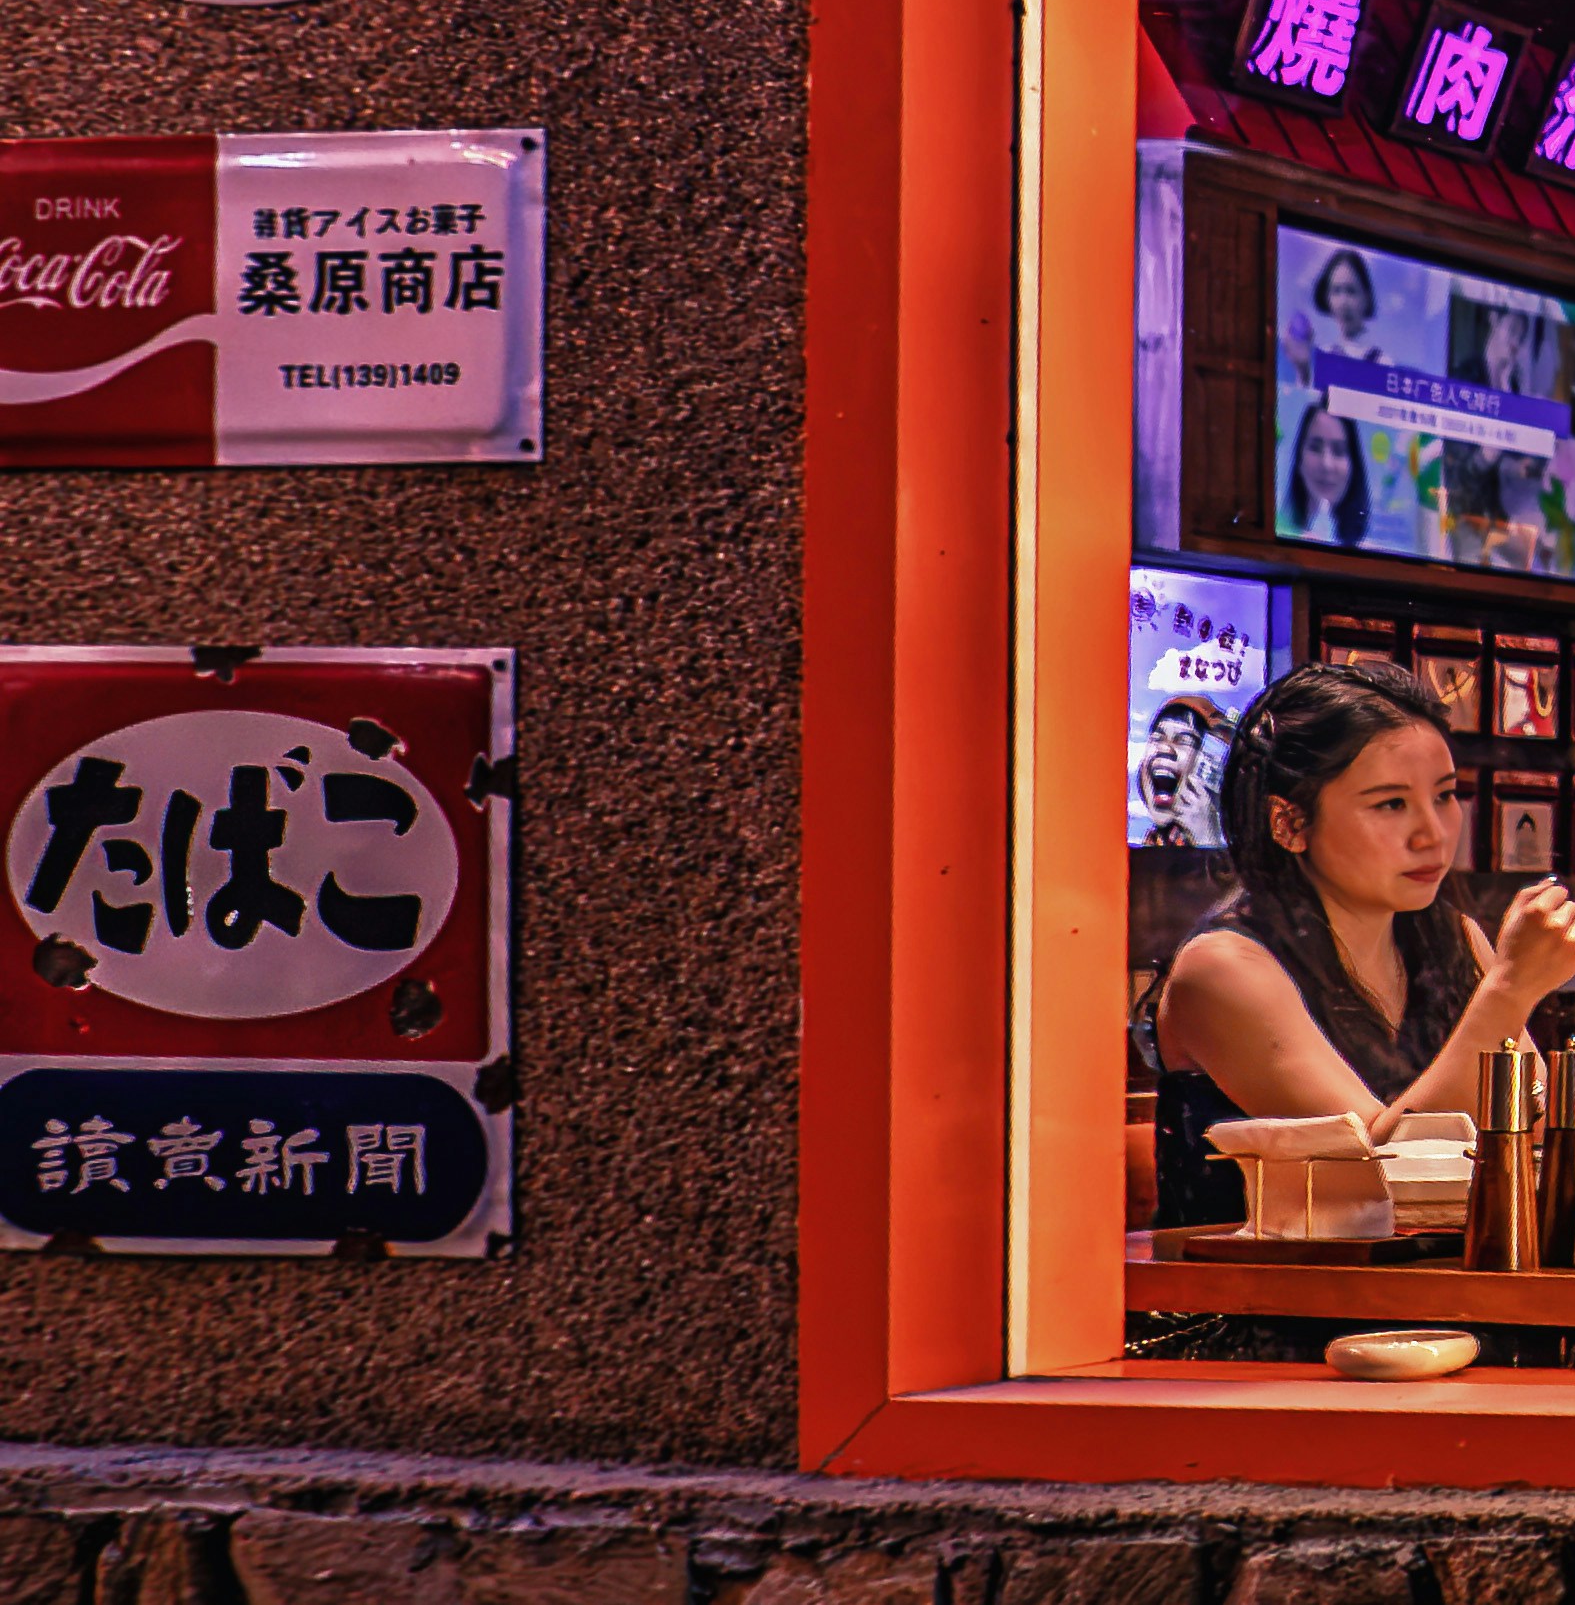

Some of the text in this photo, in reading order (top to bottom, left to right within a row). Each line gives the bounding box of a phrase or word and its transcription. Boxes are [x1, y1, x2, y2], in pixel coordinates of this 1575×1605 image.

[34, 198, 121, 220] DRINK
[238, 244, 504, 316] 桑原商店
[279, 362, 461, 389] TEL(139)1409
[25, 746, 423, 954] たばこ
